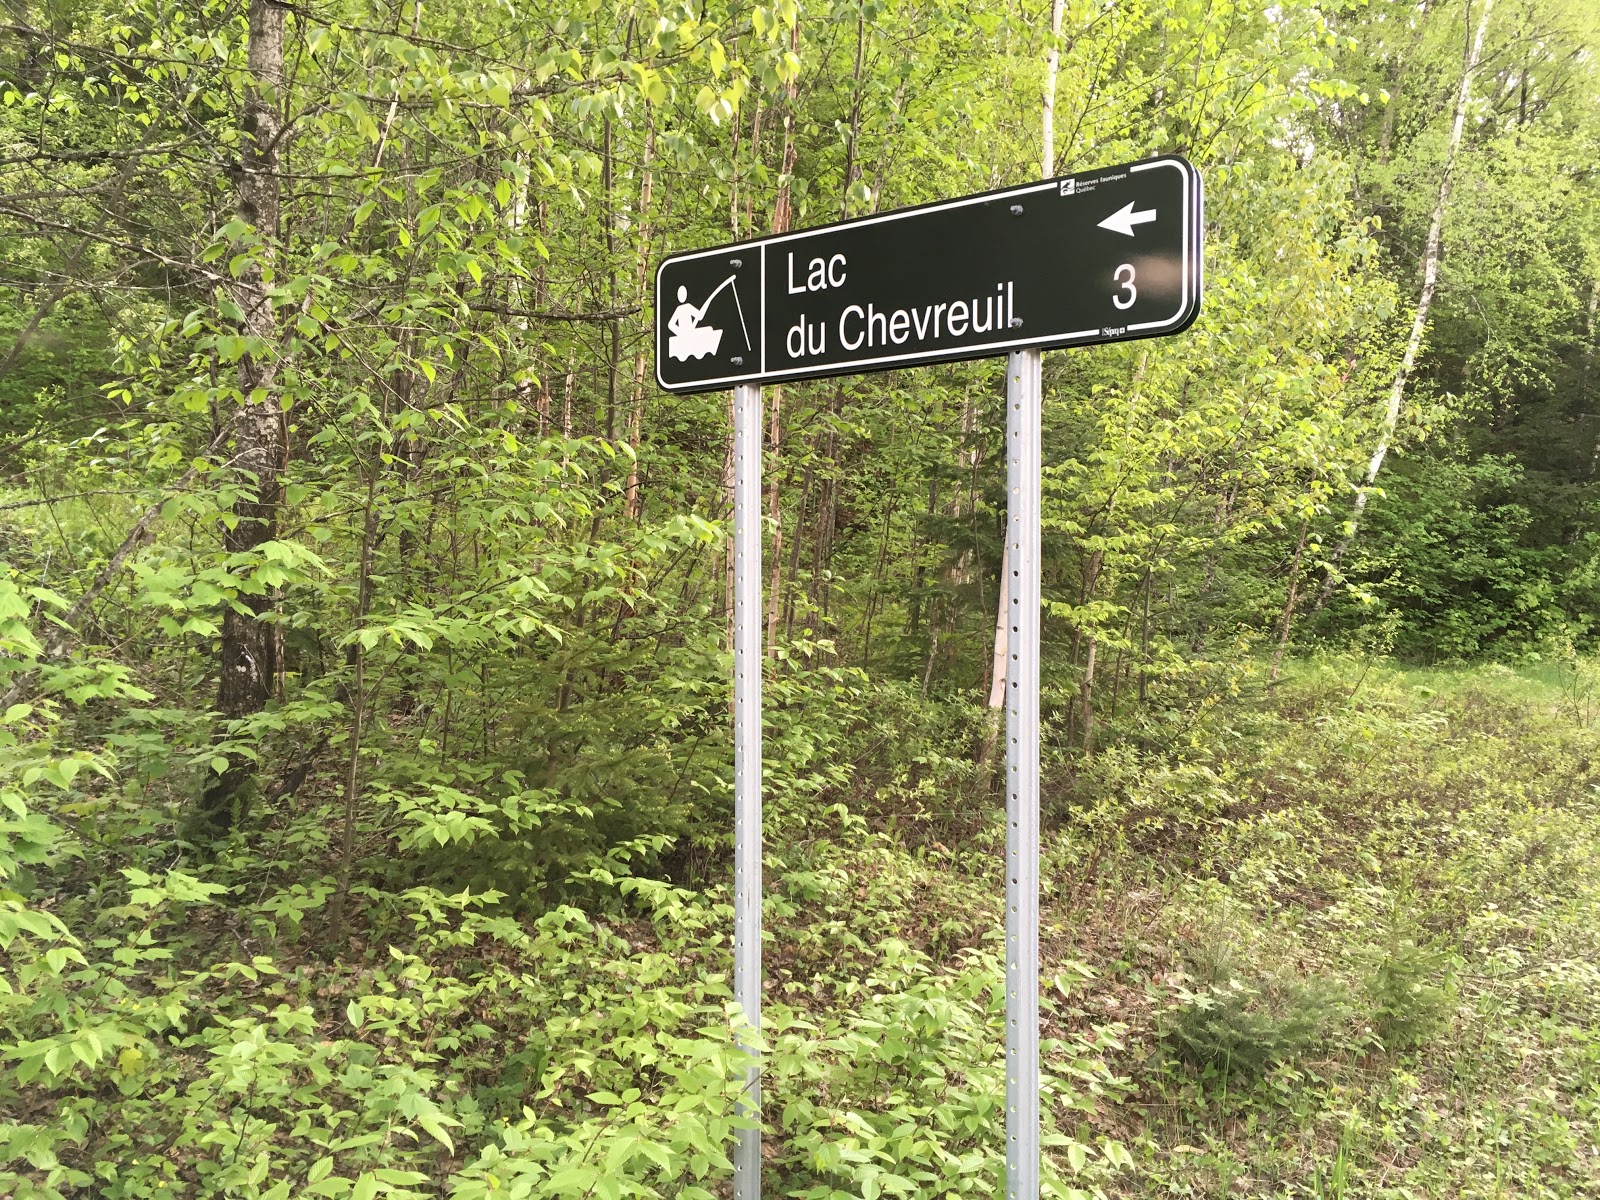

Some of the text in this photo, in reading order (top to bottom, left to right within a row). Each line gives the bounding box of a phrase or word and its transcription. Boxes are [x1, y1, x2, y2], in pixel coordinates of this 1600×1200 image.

[1076, 173, 1127, 187] Réserves fauniques
[1076, 186, 1096, 194] Québec
[788, 251, 847, 295] Lac
[1112, 264, 1137, 310] 3
[786, 281, 1014, 359] du Chevreuil
